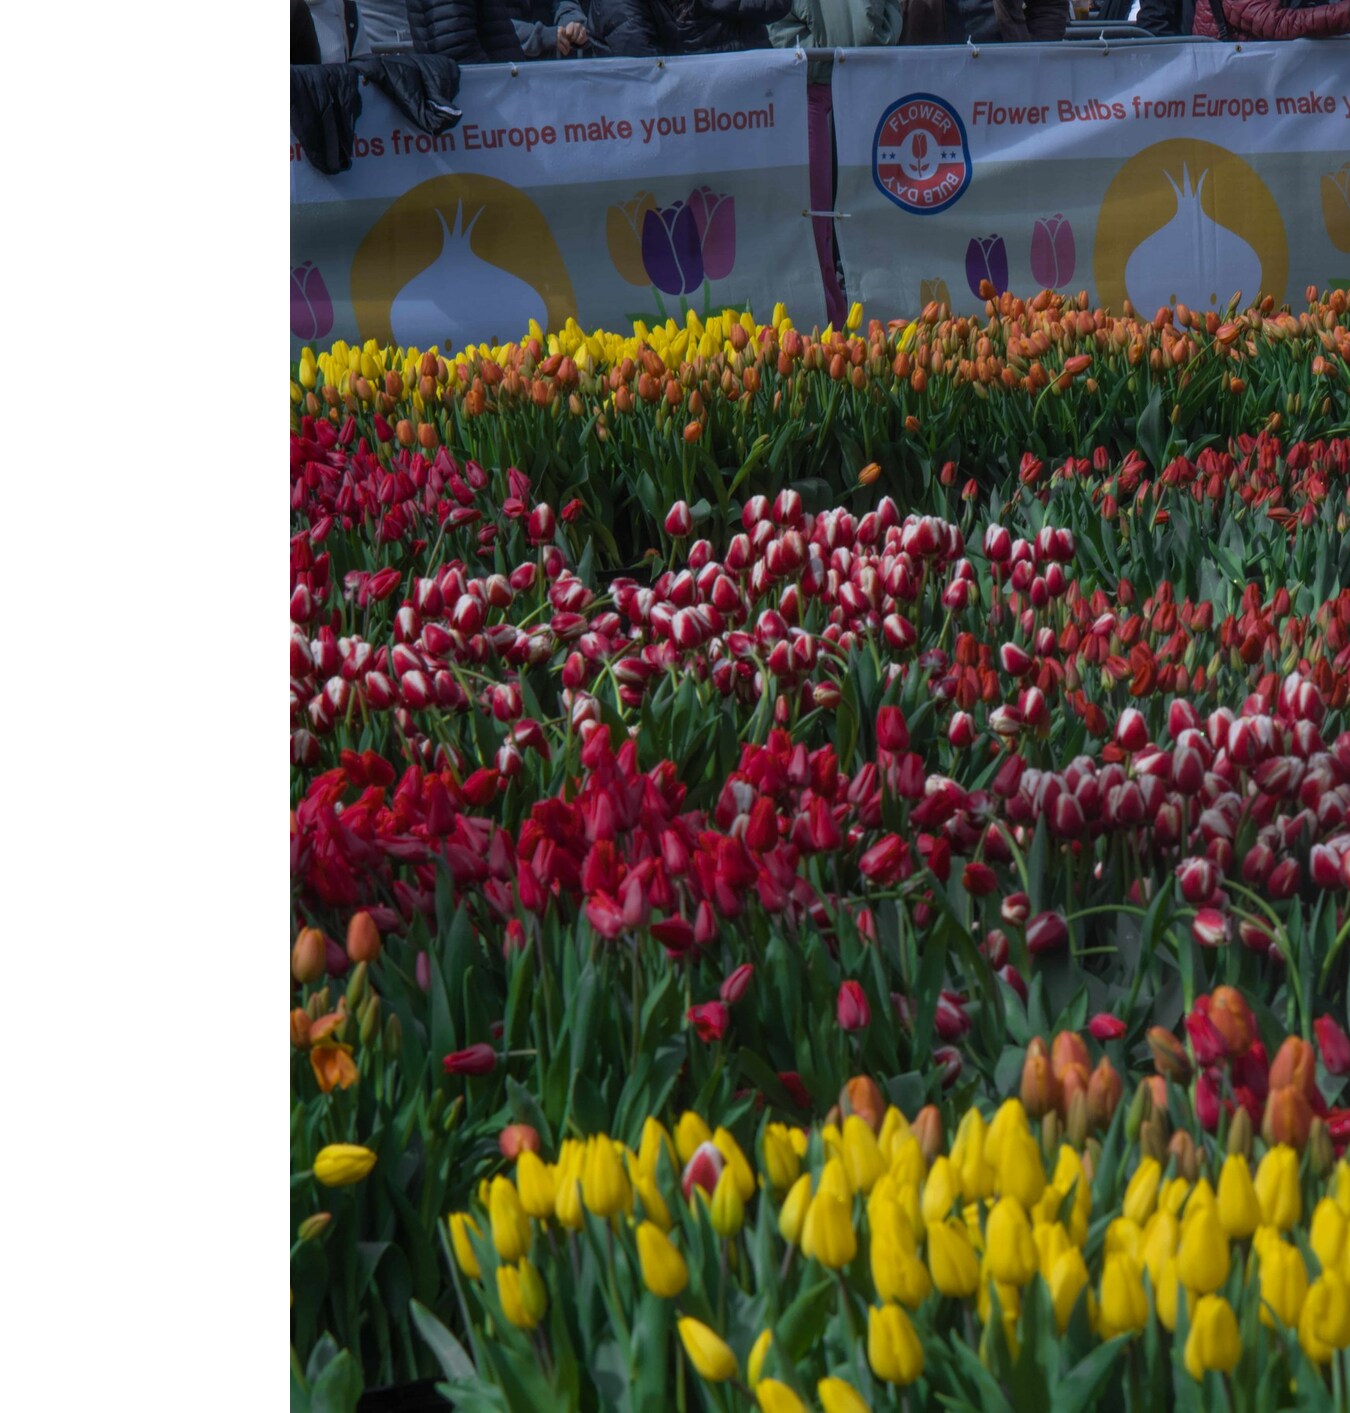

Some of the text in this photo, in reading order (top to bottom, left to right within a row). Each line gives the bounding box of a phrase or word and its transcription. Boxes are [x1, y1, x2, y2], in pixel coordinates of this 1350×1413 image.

[888, 104, 952, 134] FLOWER
[972, 101, 1050, 126] Flower
[1057, 97, 1127, 123] Bulbs
[1131, 94, 1186, 119] from
[1192, 93, 1269, 126] Europe
[1276, 88, 1336, 116] make
[391, 128, 457, 156] from
[462, 124, 558, 153] Europe
[564, 115, 634, 144] make
[641, 112, 687, 144] you
[693, 103, 775, 133] Bloom!
[883, 172, 960, 203] BULB DAY
